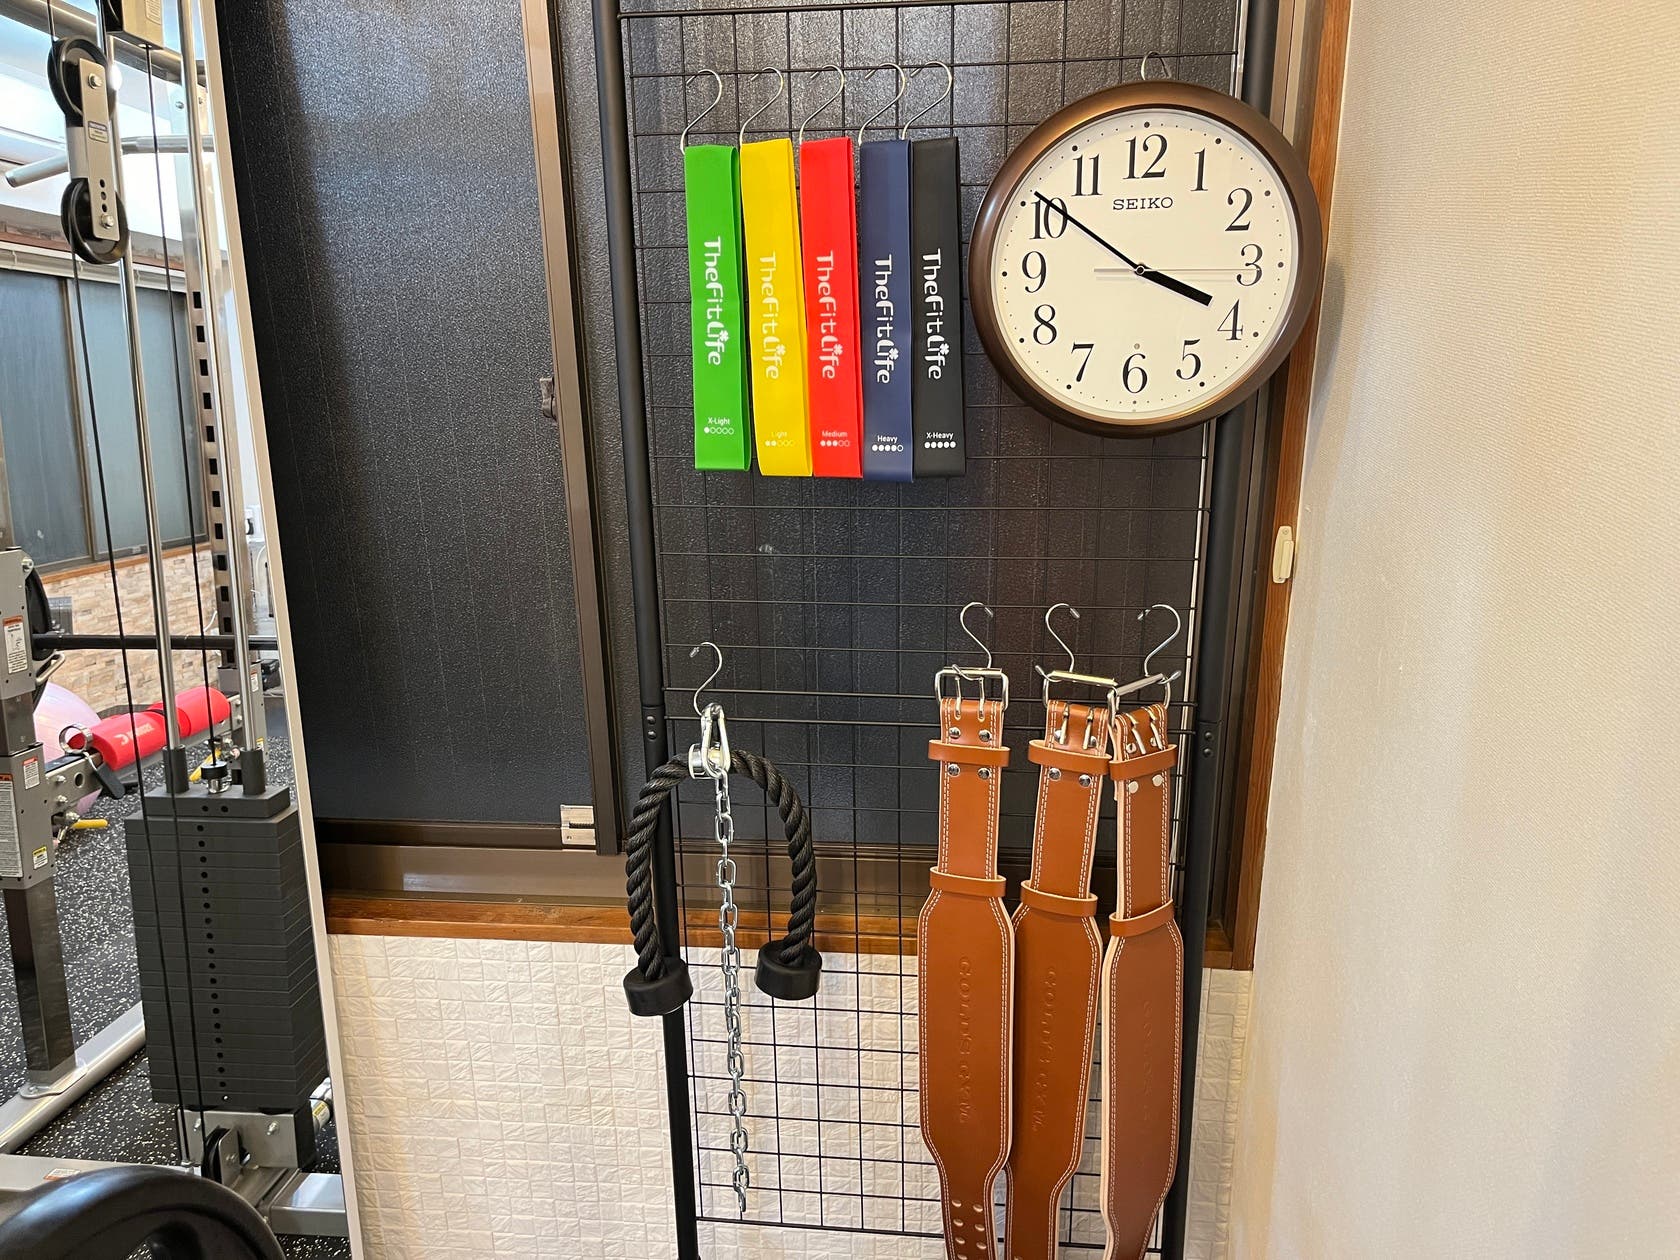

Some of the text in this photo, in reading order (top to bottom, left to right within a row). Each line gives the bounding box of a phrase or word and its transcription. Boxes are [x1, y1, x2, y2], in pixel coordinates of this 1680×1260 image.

[1071, 153, 1104, 197] 11
[1122, 133, 1168, 180] 12
[1190, 147, 1209, 192] 1
[1029, 197, 1069, 241] 10
[1112, 196, 1174, 211] SEIKO
[1224, 187, 1254, 232] 2
[1021, 250, 1048, 294] 9
[1236, 243, 1264, 287] 3
[703, 235, 730, 367] TheFitLife
[758, 250, 787, 380] TheFitLife
[815, 249, 843, 380] TheFitLife
[873, 253, 900, 385] TheFitLife
[921, 248, 950, 380] TheFitLife
[1216, 298, 1245, 342] 4
[1032, 303, 1058, 346] 8
[1070, 342, 1095, 383] 7
[1121, 352, 1149, 394] 6
[1175, 338, 1202, 381] 5
[707, 417, 731, 427] X-Light
[771, 431, 788, 440] Light
[877, 435, 898, 443] Heavy
[926, 432, 954, 440] X-Heavy
